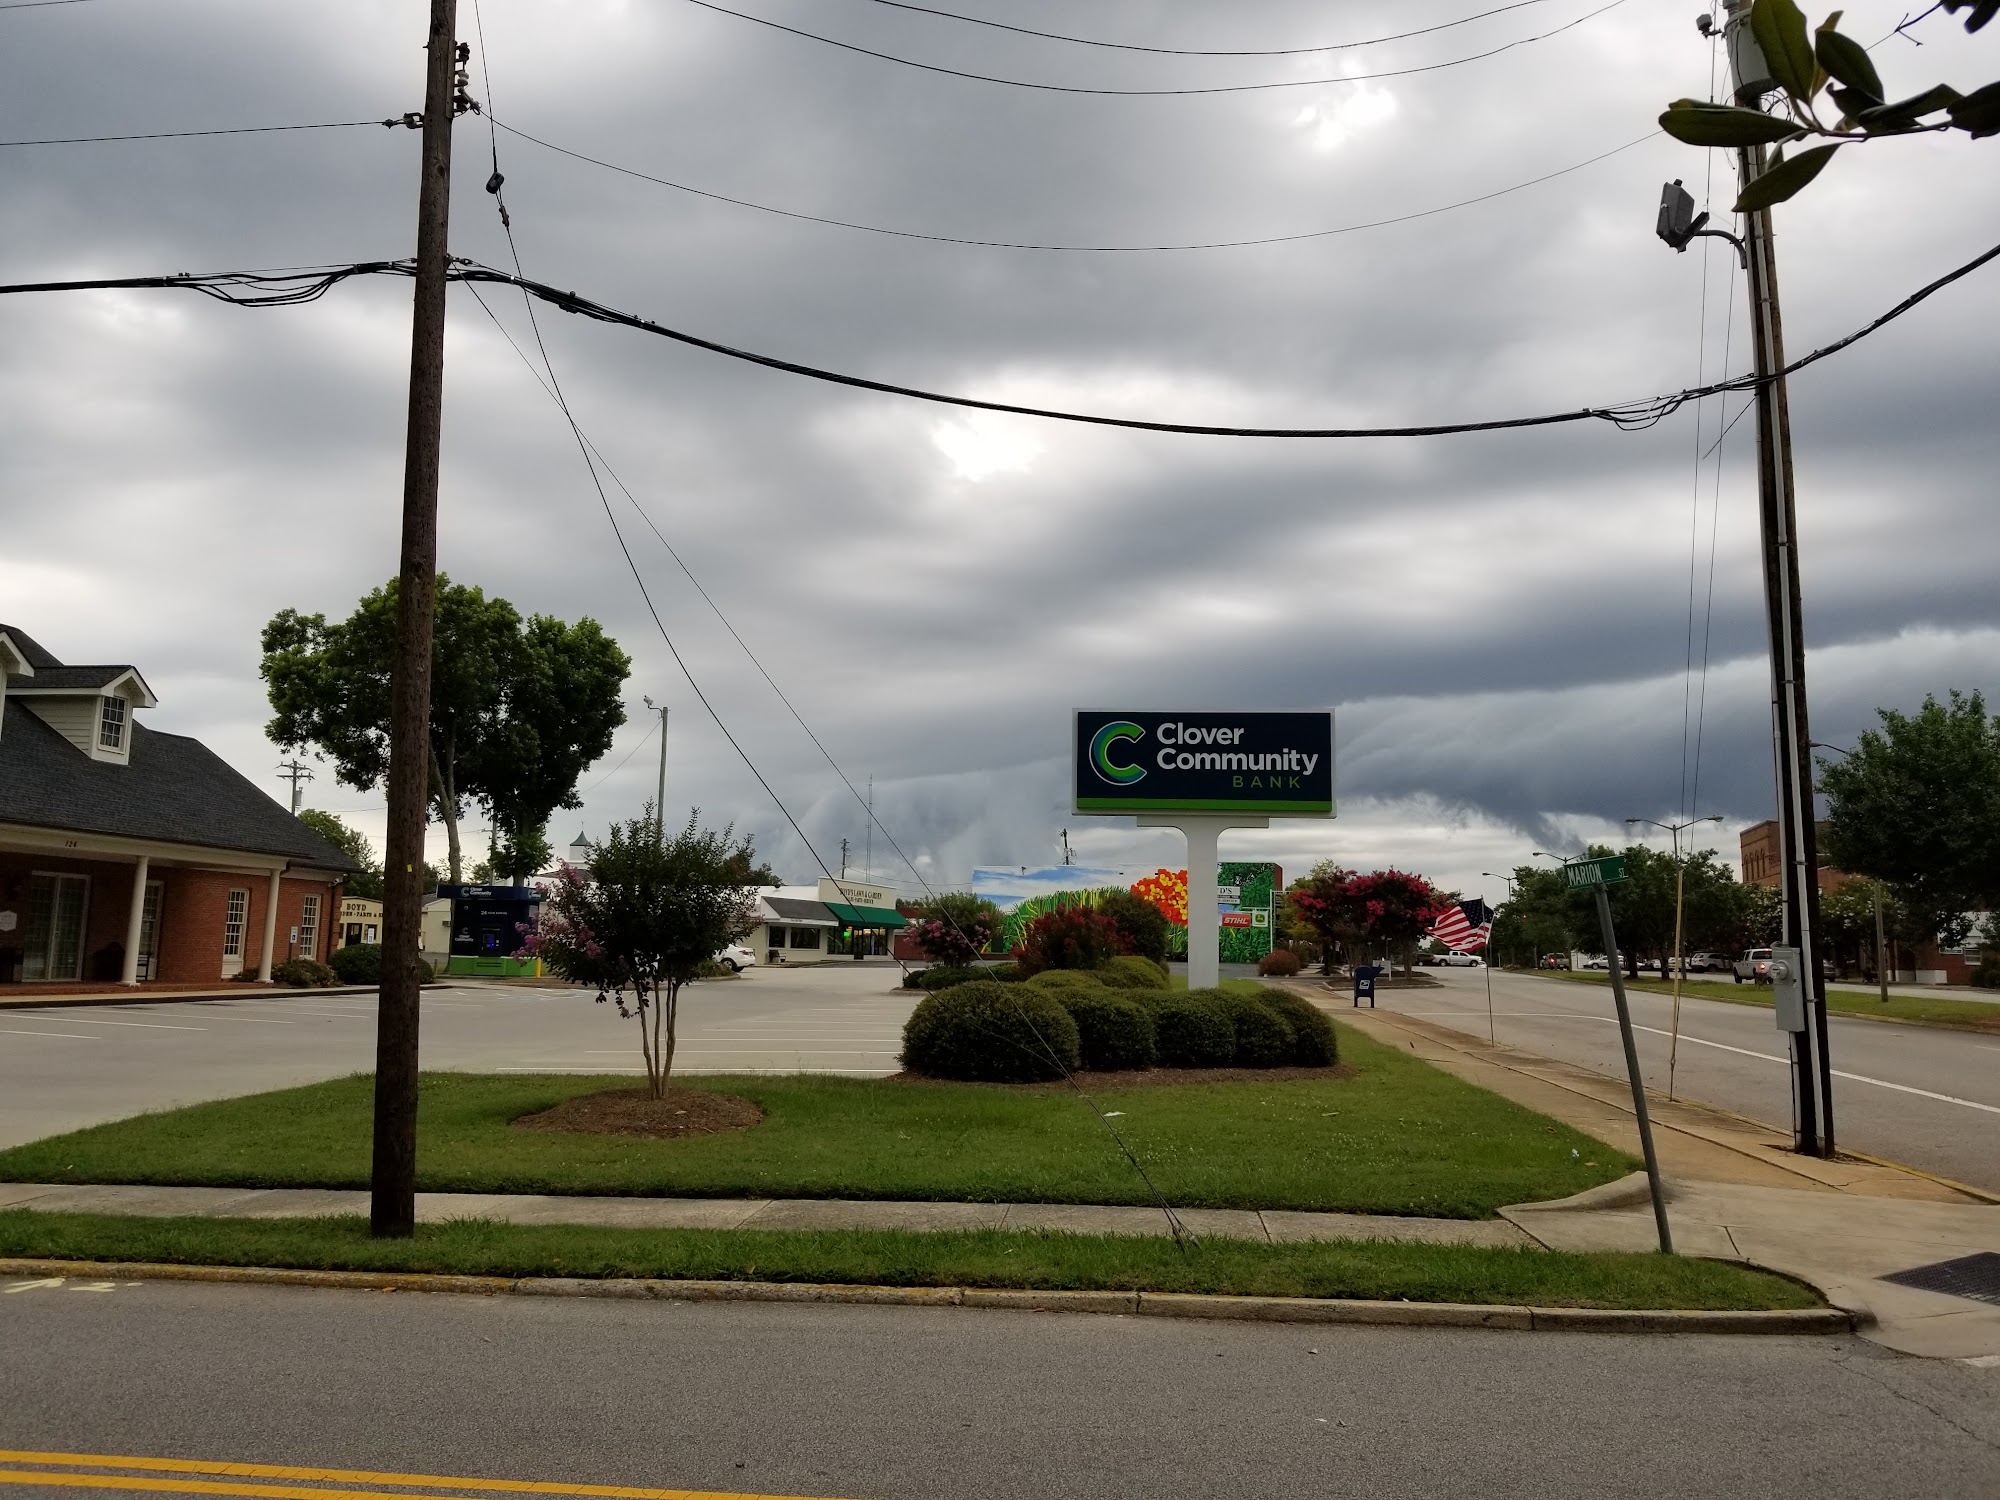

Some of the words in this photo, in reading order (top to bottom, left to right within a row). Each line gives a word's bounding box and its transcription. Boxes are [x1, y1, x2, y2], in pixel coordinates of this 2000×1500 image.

[1156, 722, 1245, 745] Clover
[1156, 747, 1319, 775] Community
[1232, 775, 1301, 789] BANK
[1567, 863, 1602, 886] MARION
[346, 903, 367, 911] BOYD
[1224, 917, 1249, 925] STIHL
